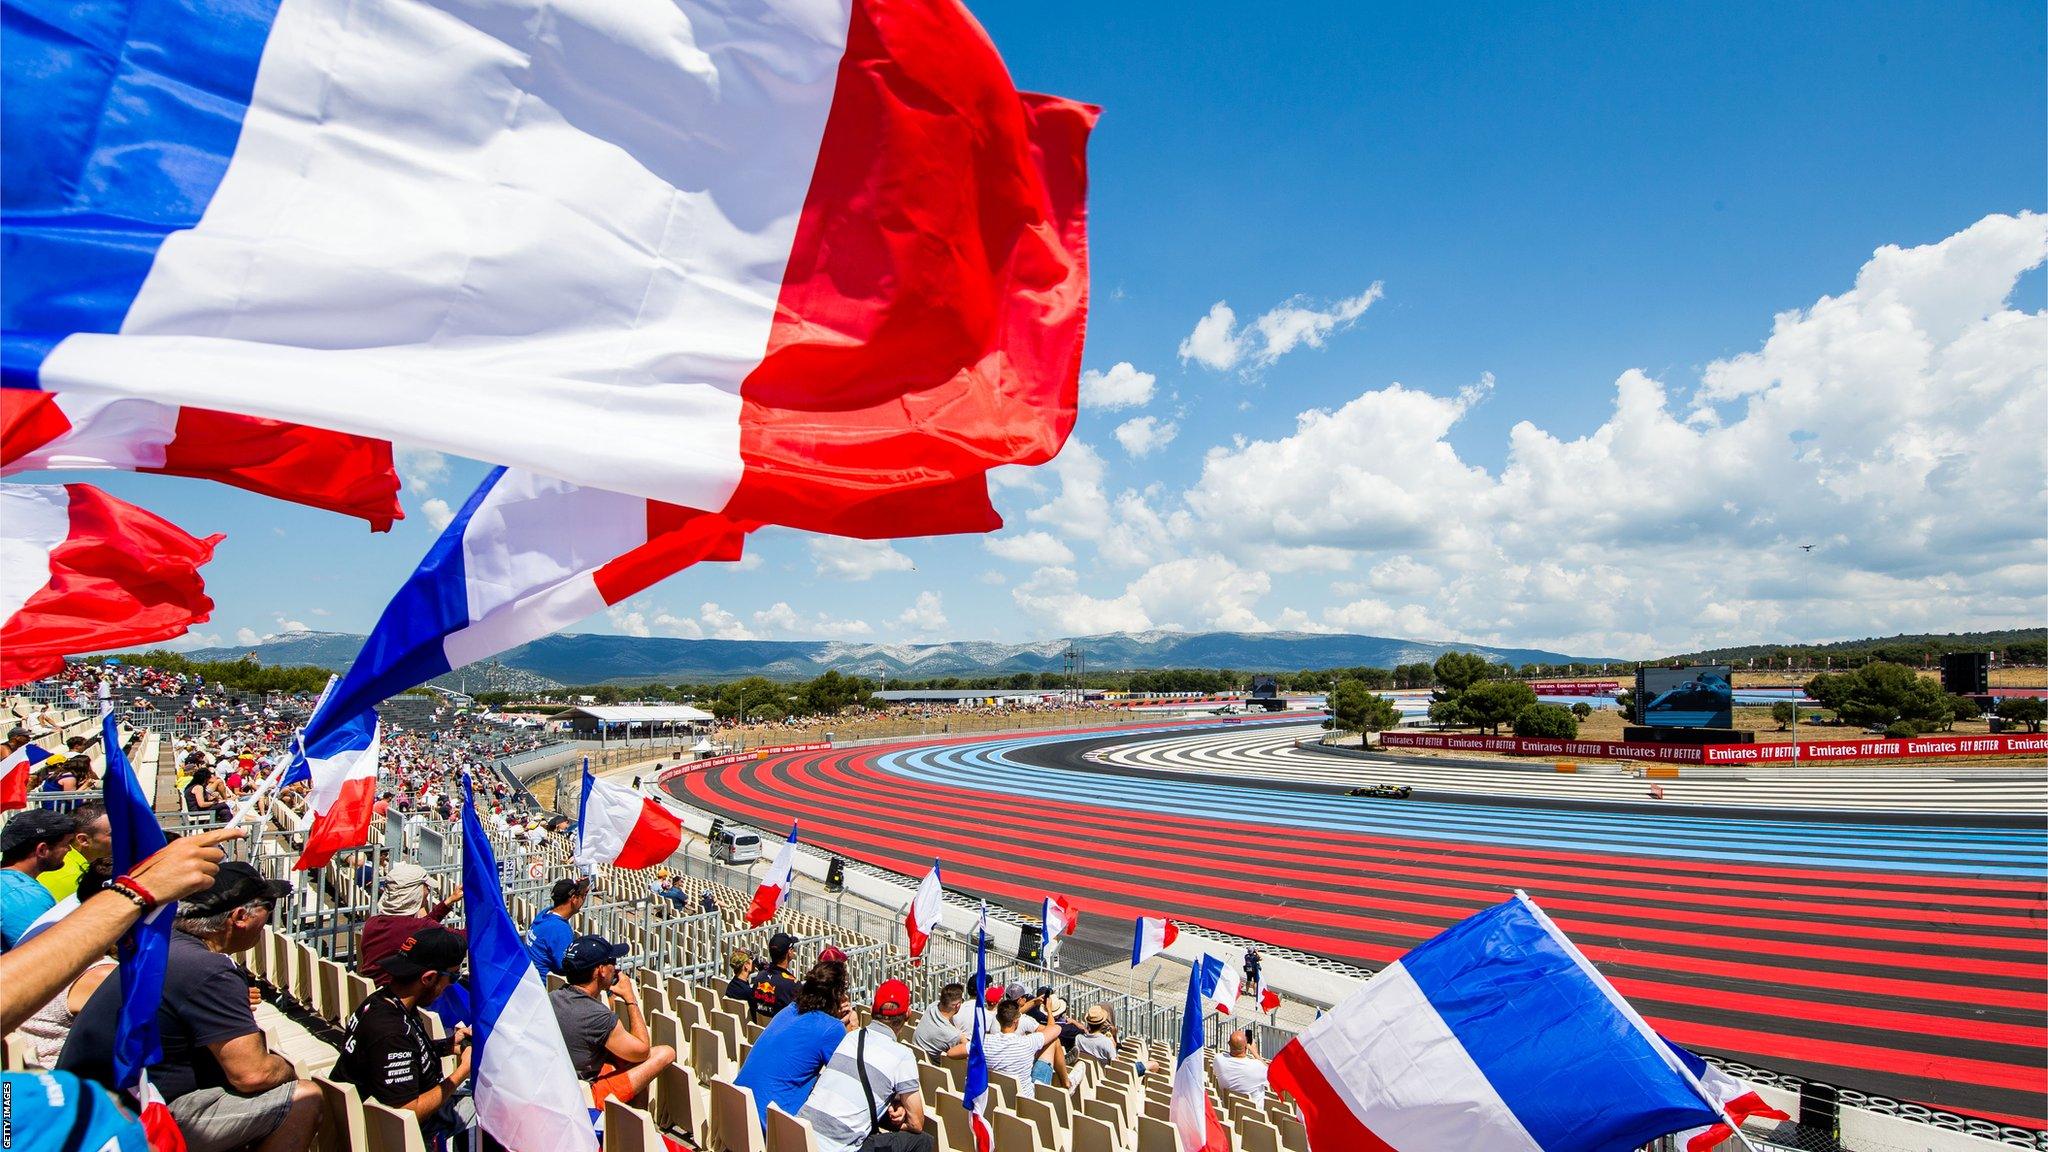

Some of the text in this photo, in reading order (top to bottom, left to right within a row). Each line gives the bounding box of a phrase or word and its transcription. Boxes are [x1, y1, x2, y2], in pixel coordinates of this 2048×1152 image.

[1382, 735, 1701, 760] Emirates FLY BETTER Emirates FLY BETTER Emirates FLY BETTER Emirates FLY BETTER
[1709, 748, 1757, 760] Emirates
[1761, 747, 1773, 758] FLY
[1809, 745, 1857, 757] Emirates
[1860, 744, 1873, 755] FLY
[1874, 743, 1900, 754] BETTER
[1908, 742, 1956, 753] Emirates
[1960, 740, 1972, 751] FLY
[1973, 740, 1999, 751] BETTER
[388, 1051, 412, 1060] EPSON
